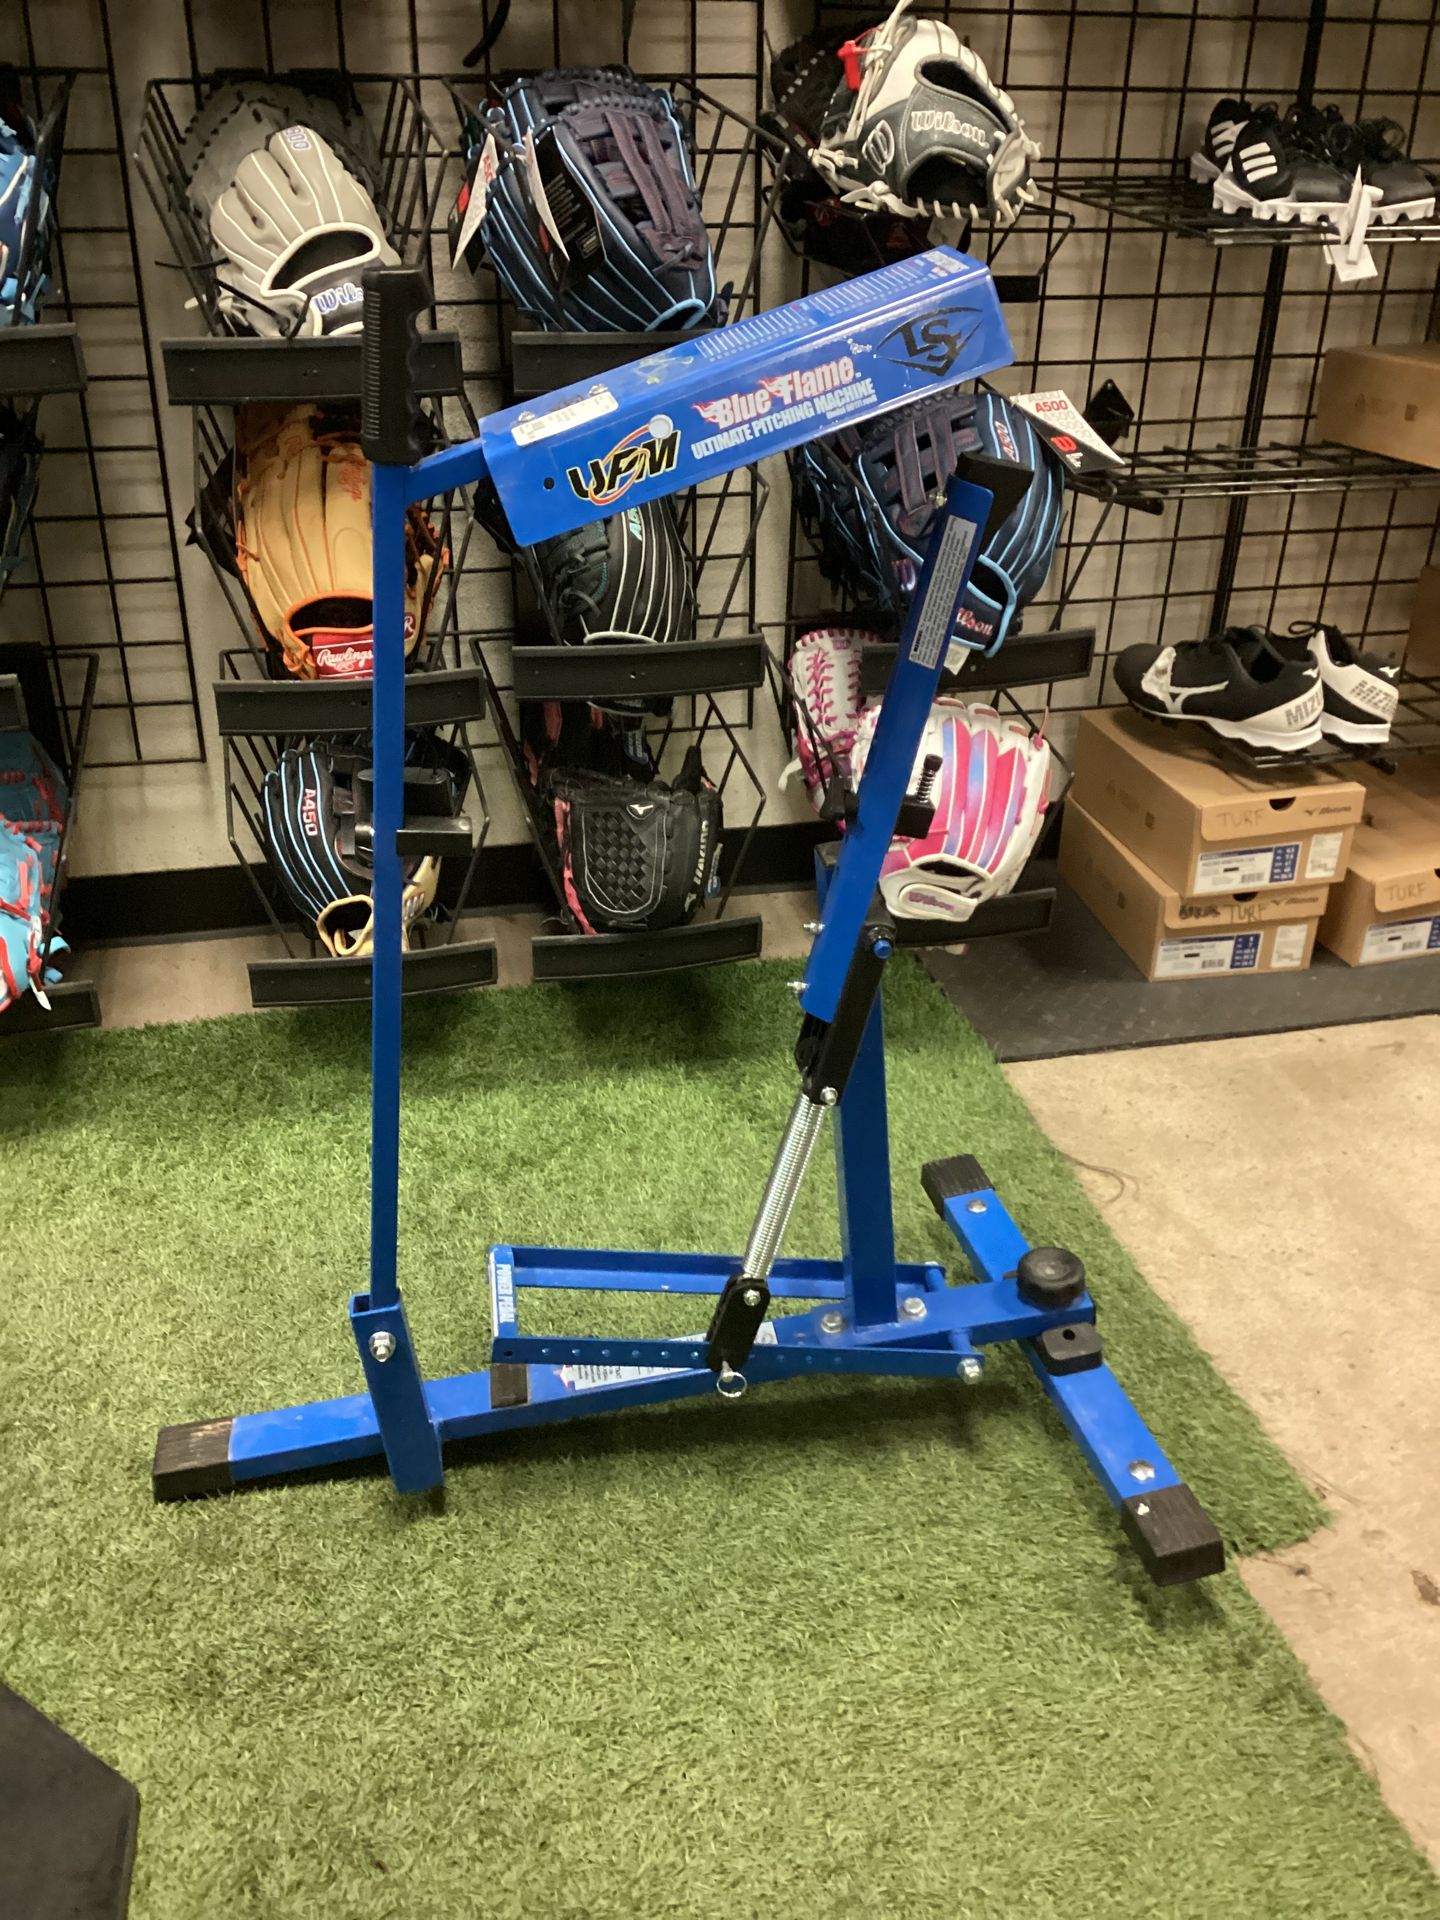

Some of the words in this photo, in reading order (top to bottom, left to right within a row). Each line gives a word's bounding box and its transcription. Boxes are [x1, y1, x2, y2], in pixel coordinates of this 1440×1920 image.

[911, 110, 987, 147] Wilson
[690, 427, 753, 460] ULTIMATE
[754, 403, 815, 438] PITCHING
[814, 378, 876, 414] MACHINE
[695, 386, 772, 430] Blue
[1035, 400, 1068, 413] A500
[566, 430, 682, 500] UPM
[955, 607, 993, 636] ilson
[317, 646, 374, 669] Rawlings
[302, 788, 318, 836] A450
[1216, 808, 1265, 828] TURF
[1384, 882, 1426, 901] TURF
[1223, 903, 1268, 924] TURF
